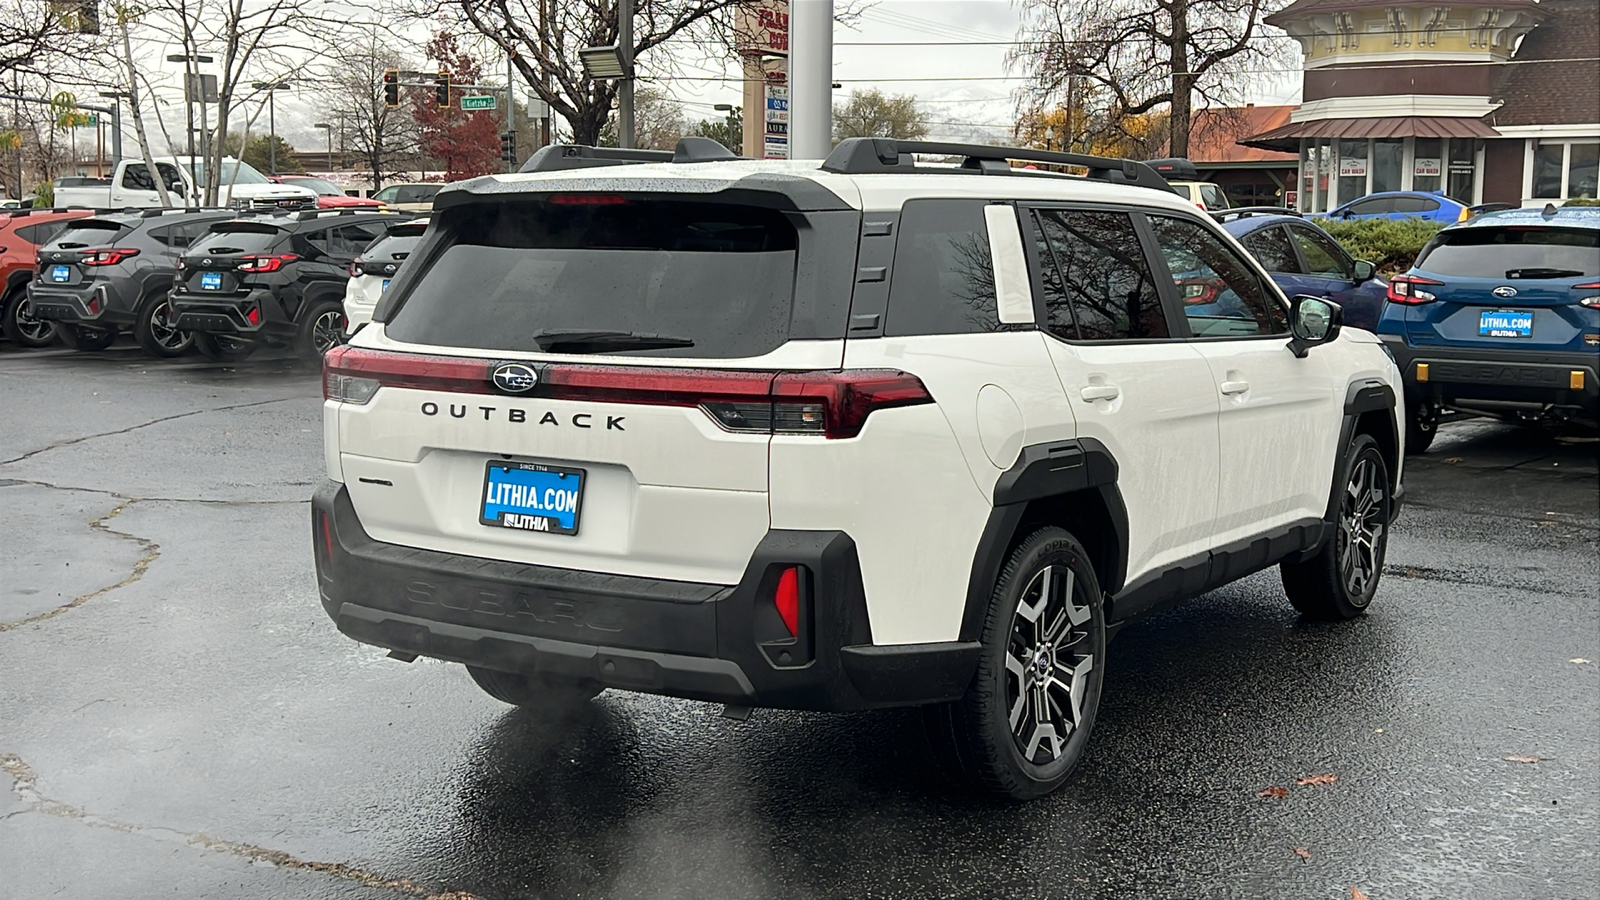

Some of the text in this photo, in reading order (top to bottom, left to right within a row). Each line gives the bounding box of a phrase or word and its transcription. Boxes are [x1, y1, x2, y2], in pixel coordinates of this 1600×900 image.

[1480, 317, 1532, 329] LITHIA.COM
[420, 402, 626, 431] OUTBACK
[519, 463, 535, 471] SINCE
[486, 481, 579, 514] LITHIA.COM
[514, 513, 550, 532] LITHIA
